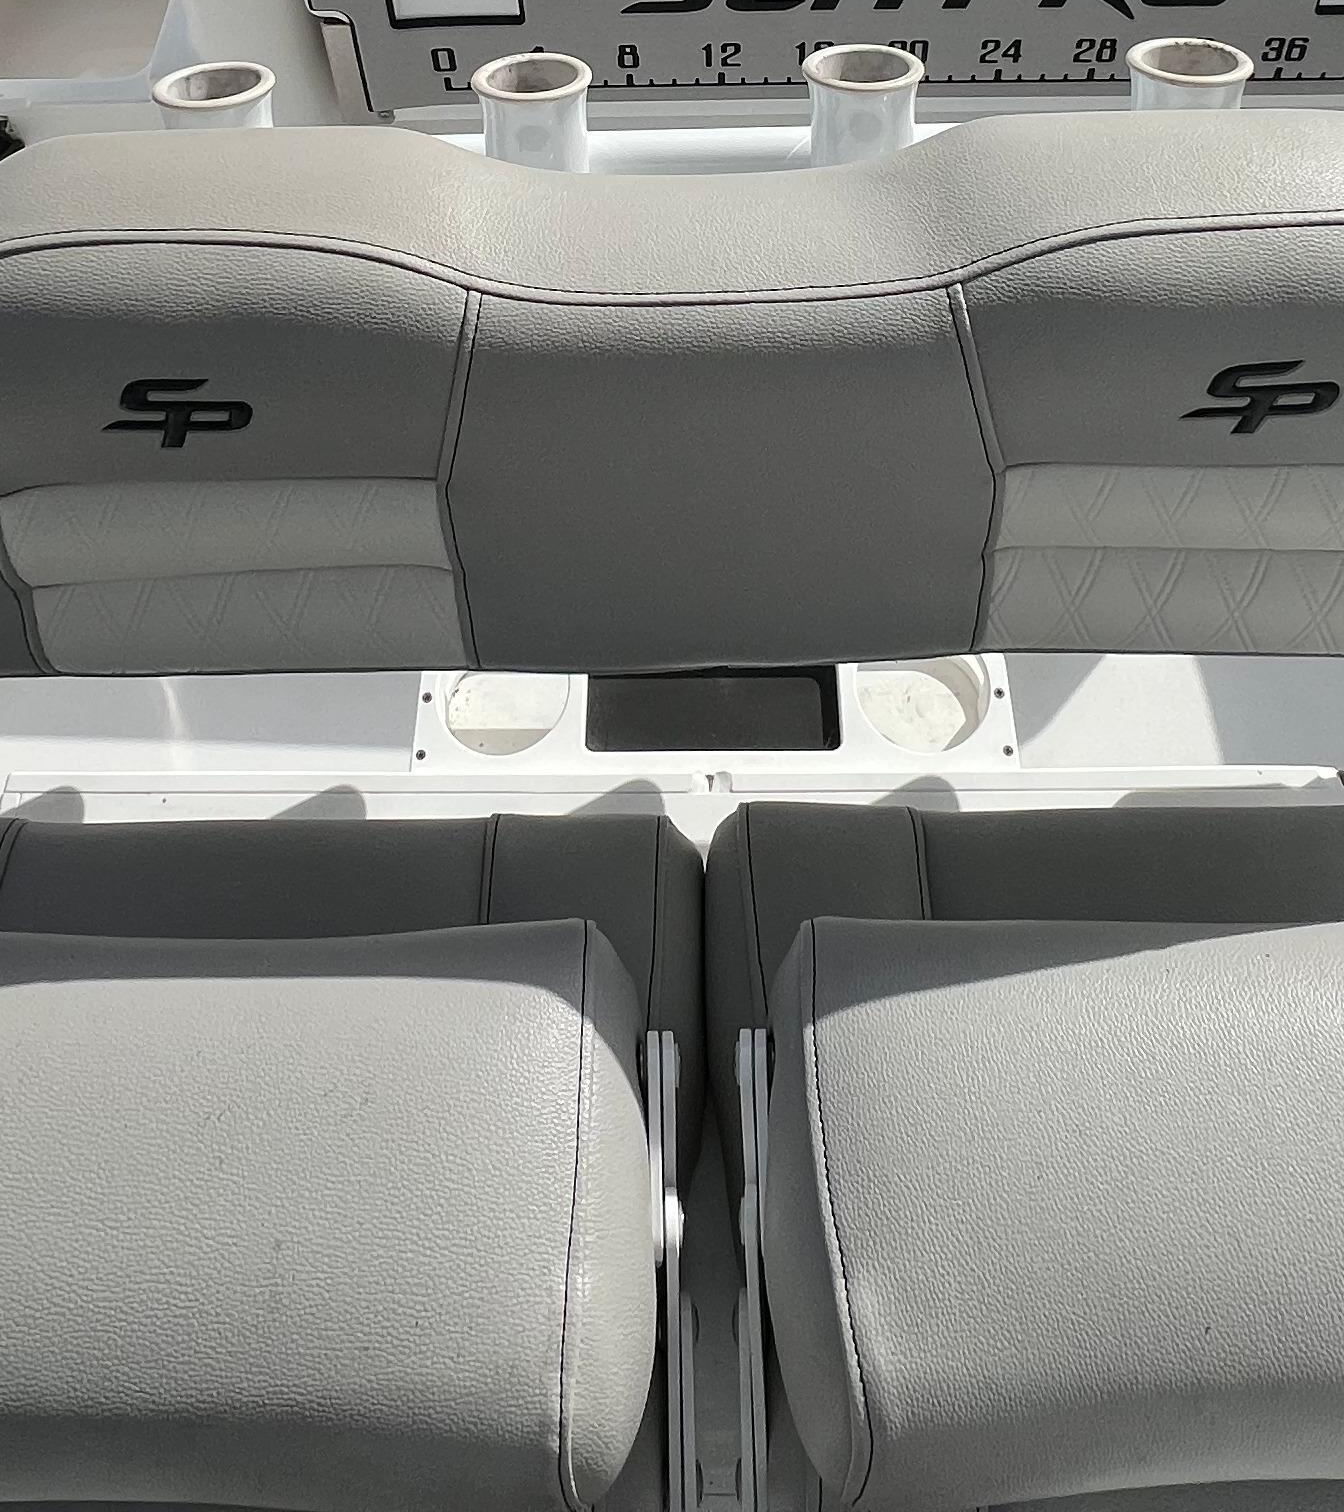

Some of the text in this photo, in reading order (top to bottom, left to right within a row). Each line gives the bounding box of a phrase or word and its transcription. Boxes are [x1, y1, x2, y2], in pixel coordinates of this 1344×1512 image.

[431, 47, 458, 73] 0
[617, 44, 640, 69] 8
[702, 42, 742, 68] 12
[979, 39, 1023, 64] 24
[1073, 38, 1118, 63] 28
[1261, 37, 1311, 62] 36
